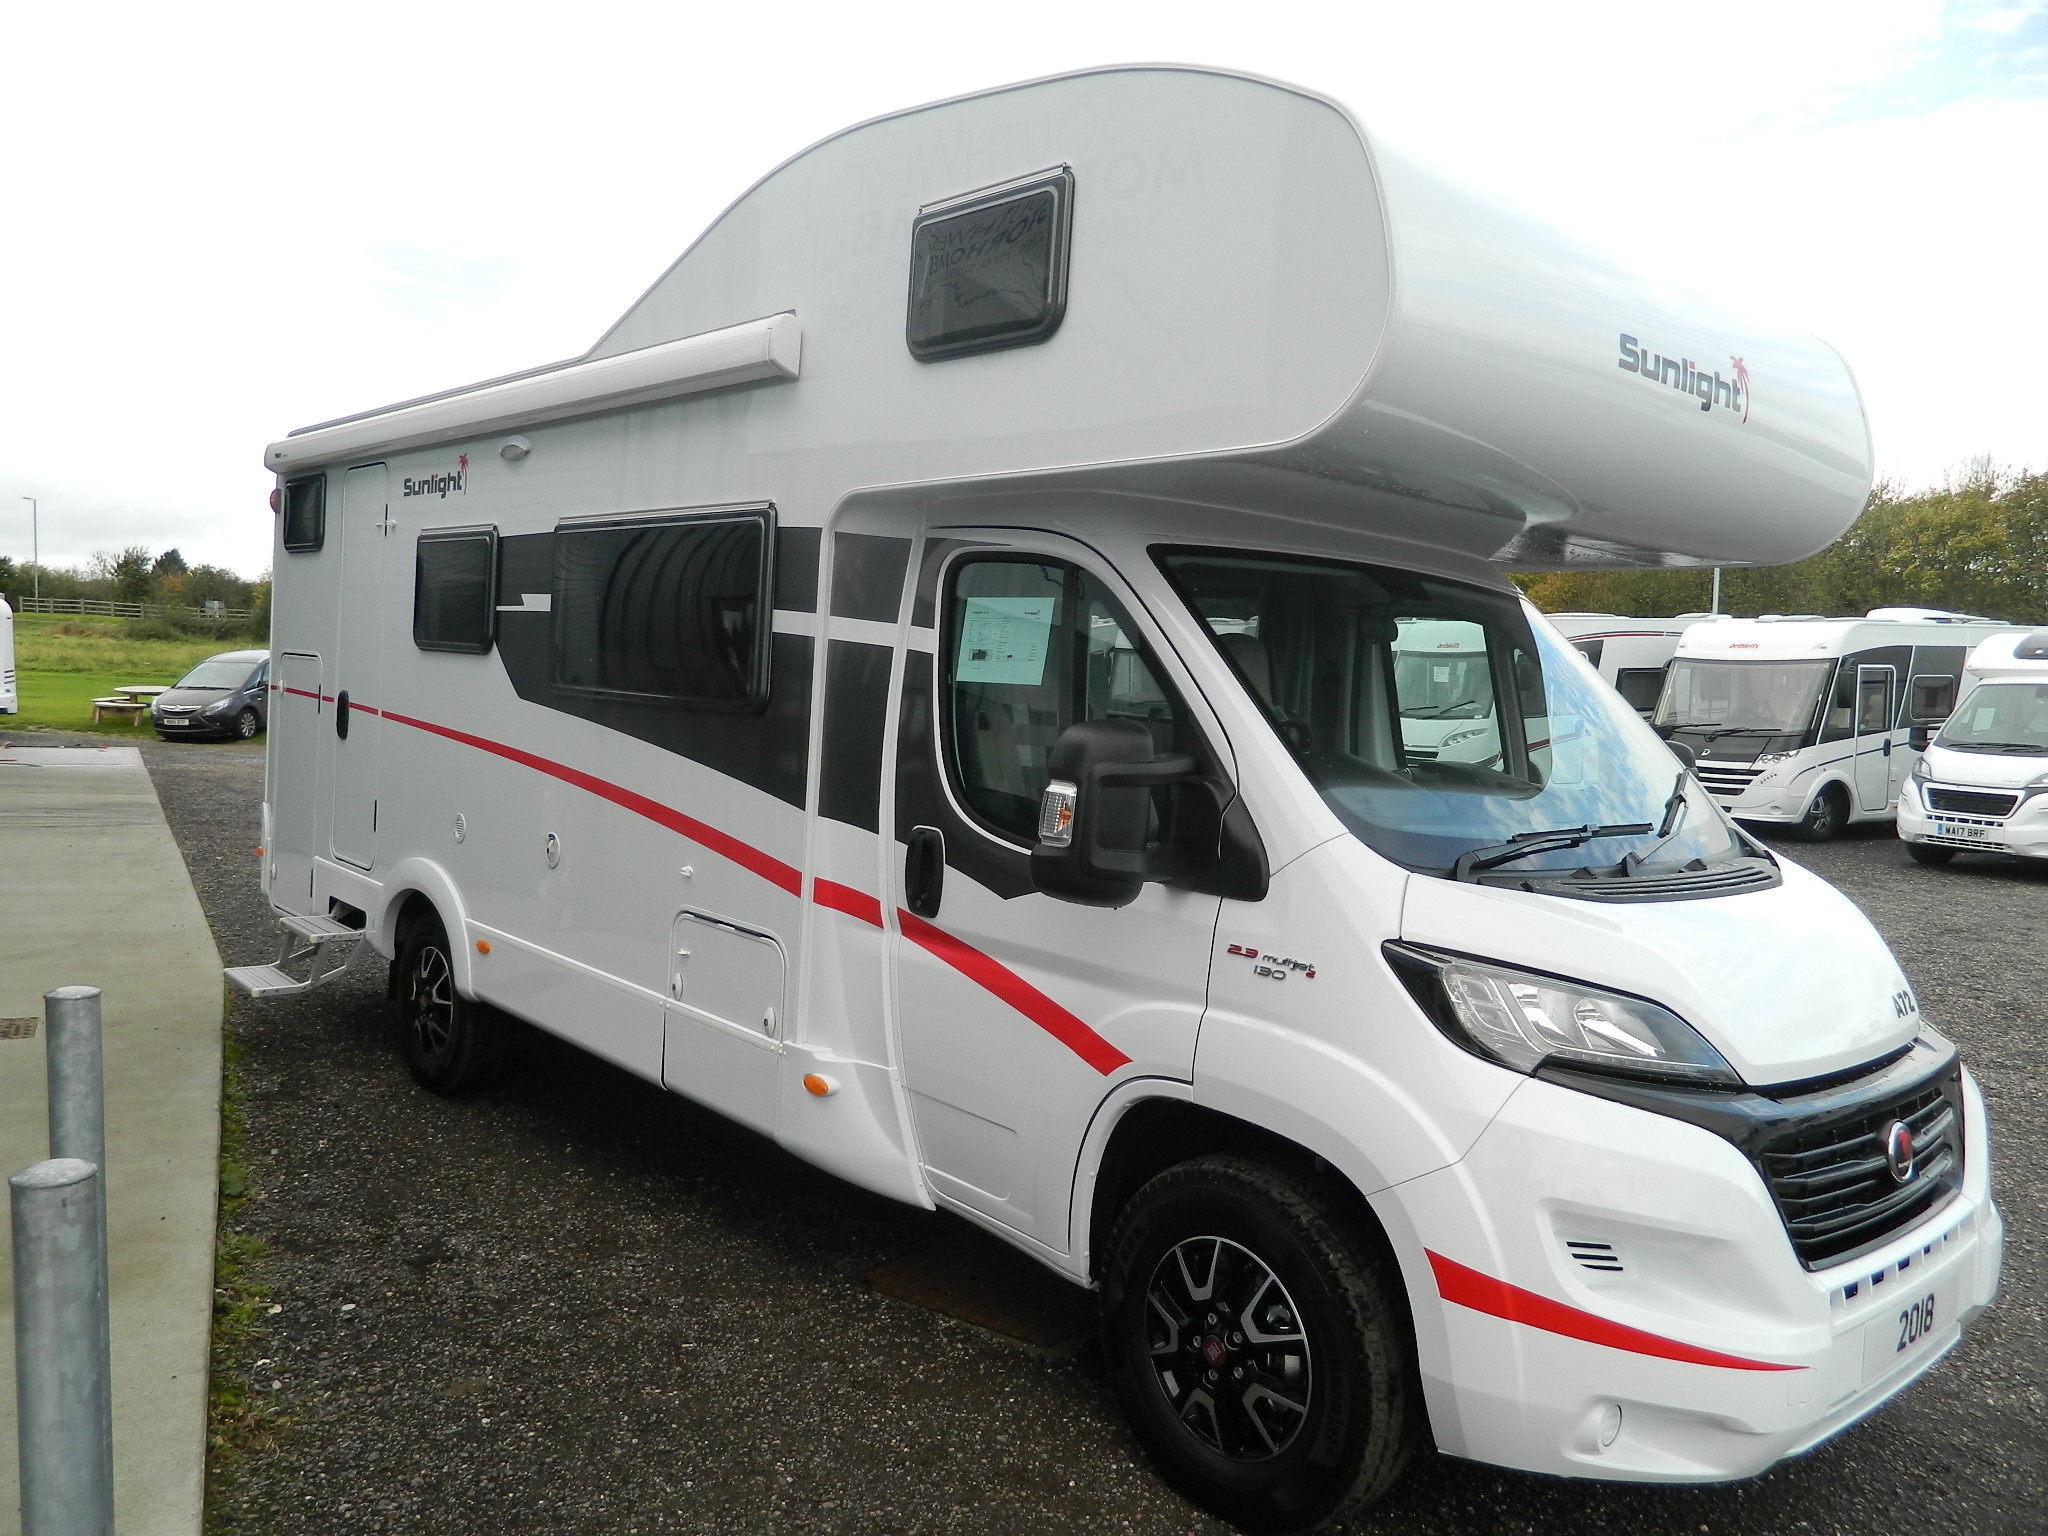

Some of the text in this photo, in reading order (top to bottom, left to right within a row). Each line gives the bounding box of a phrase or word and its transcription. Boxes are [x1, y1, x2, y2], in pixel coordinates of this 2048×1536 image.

[1618, 333, 1742, 412] Sunlight
[403, 470, 462, 499] Sunlight
[1945, 825, 1985, 838] WA17 BRF
[1253, 965, 1286, 980] 130
[1891, 990, 1916, 1018] A72
[1896, 1292, 1935, 1352] 2018
